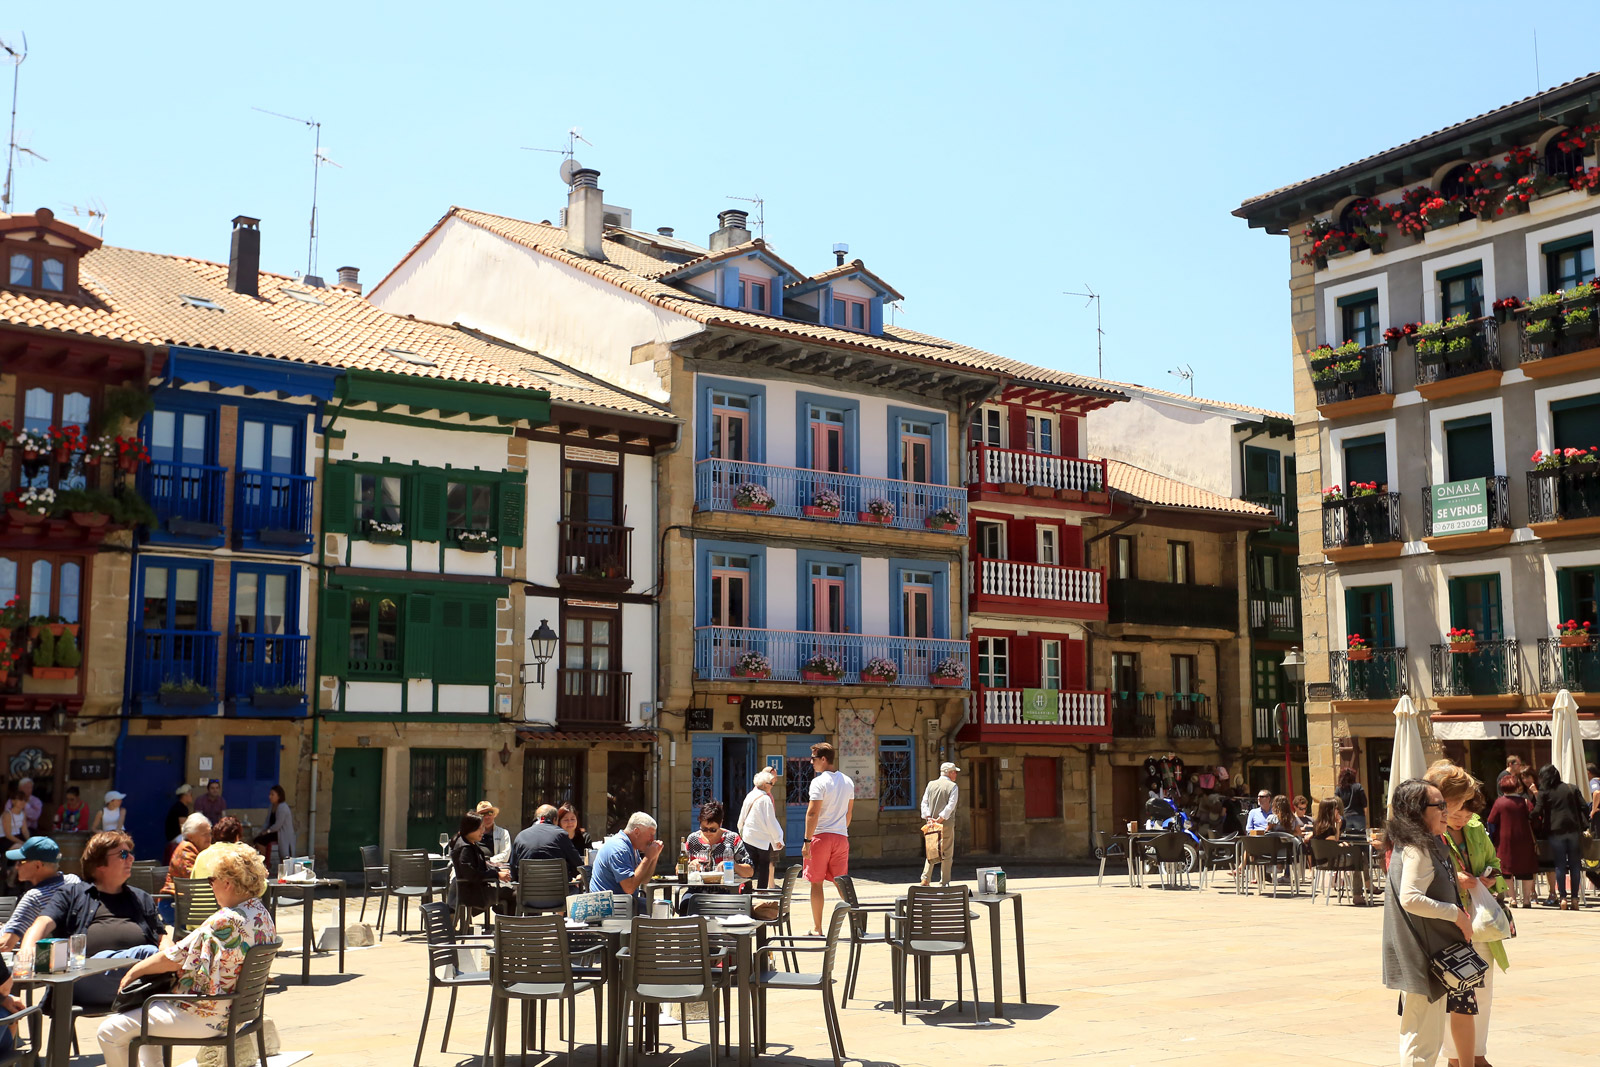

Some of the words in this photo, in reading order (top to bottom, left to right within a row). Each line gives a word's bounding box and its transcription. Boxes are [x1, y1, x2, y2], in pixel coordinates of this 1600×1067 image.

[1437, 482, 1480, 497] ONARA
[1437, 508, 1448, 519] SE
[1450, 503, 1483, 517] VENDE
[1442, 522, 1455, 531] 678
[1457, 520, 1471, 528] 230
[1472, 518, 1486, 527] 260
[750, 700, 784, 710] HOTEL
[0, 716, 41, 730] ETXEA
[746, 714, 769, 727] SAN
[771, 715, 812, 727] NICOLAS
[1499, 723, 1552, 737] TTOPARA
